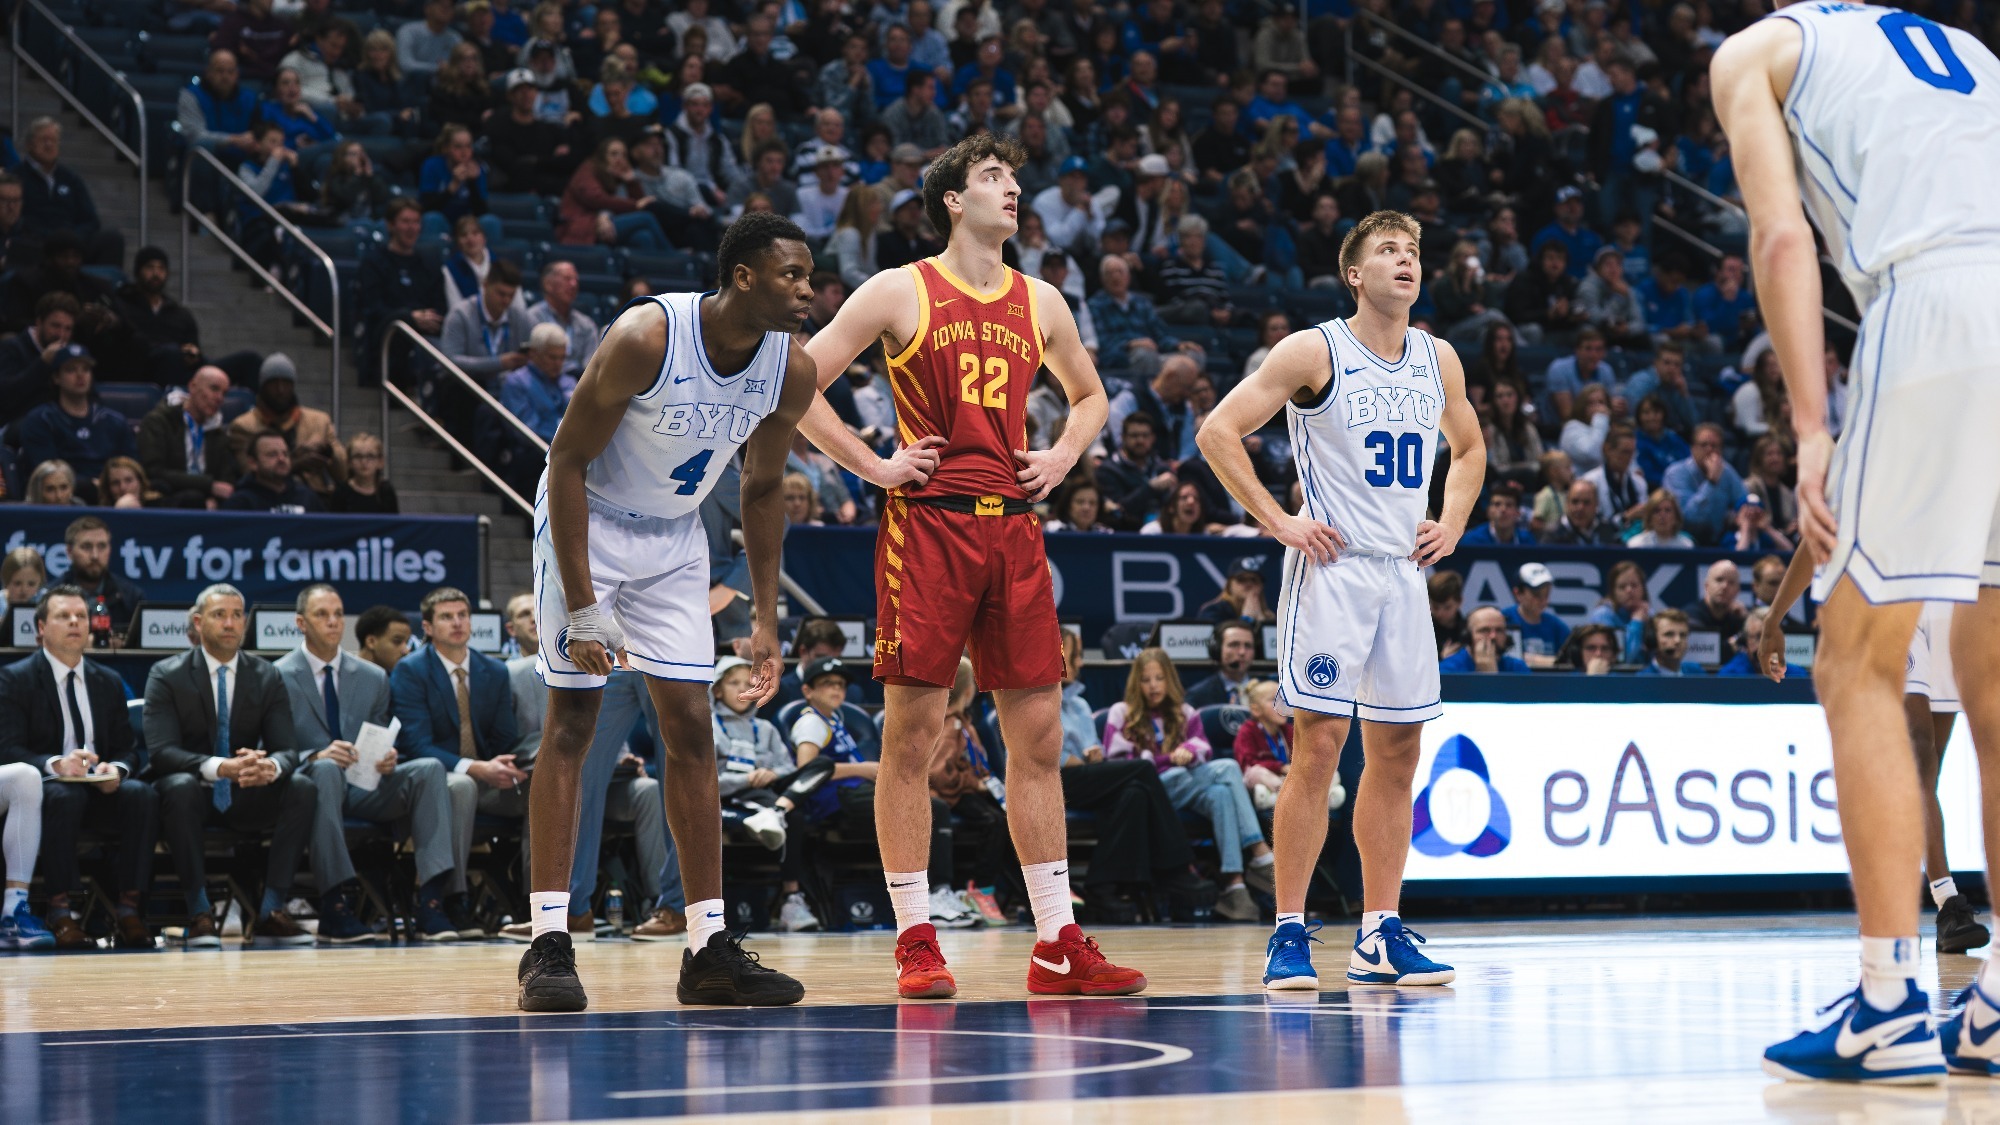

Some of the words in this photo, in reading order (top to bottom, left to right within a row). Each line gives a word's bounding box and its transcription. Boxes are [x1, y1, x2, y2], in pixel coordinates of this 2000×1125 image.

[1877, 11, 1976, 95] 0
[932, 320, 976, 351] IOWA
[982, 321, 1031, 364] STATE
[959, 352, 1009, 410] 22
[652, 402, 762, 444] BYU
[1347, 387, 1436, 430] BYU
[669, 449, 715, 495] 4
[1364, 431, 1424, 489] 30
[120, 538, 173, 580] tv
[184, 534, 252, 582] for
[262, 536, 447, 583] families
[163, 622, 189, 636] vivi
